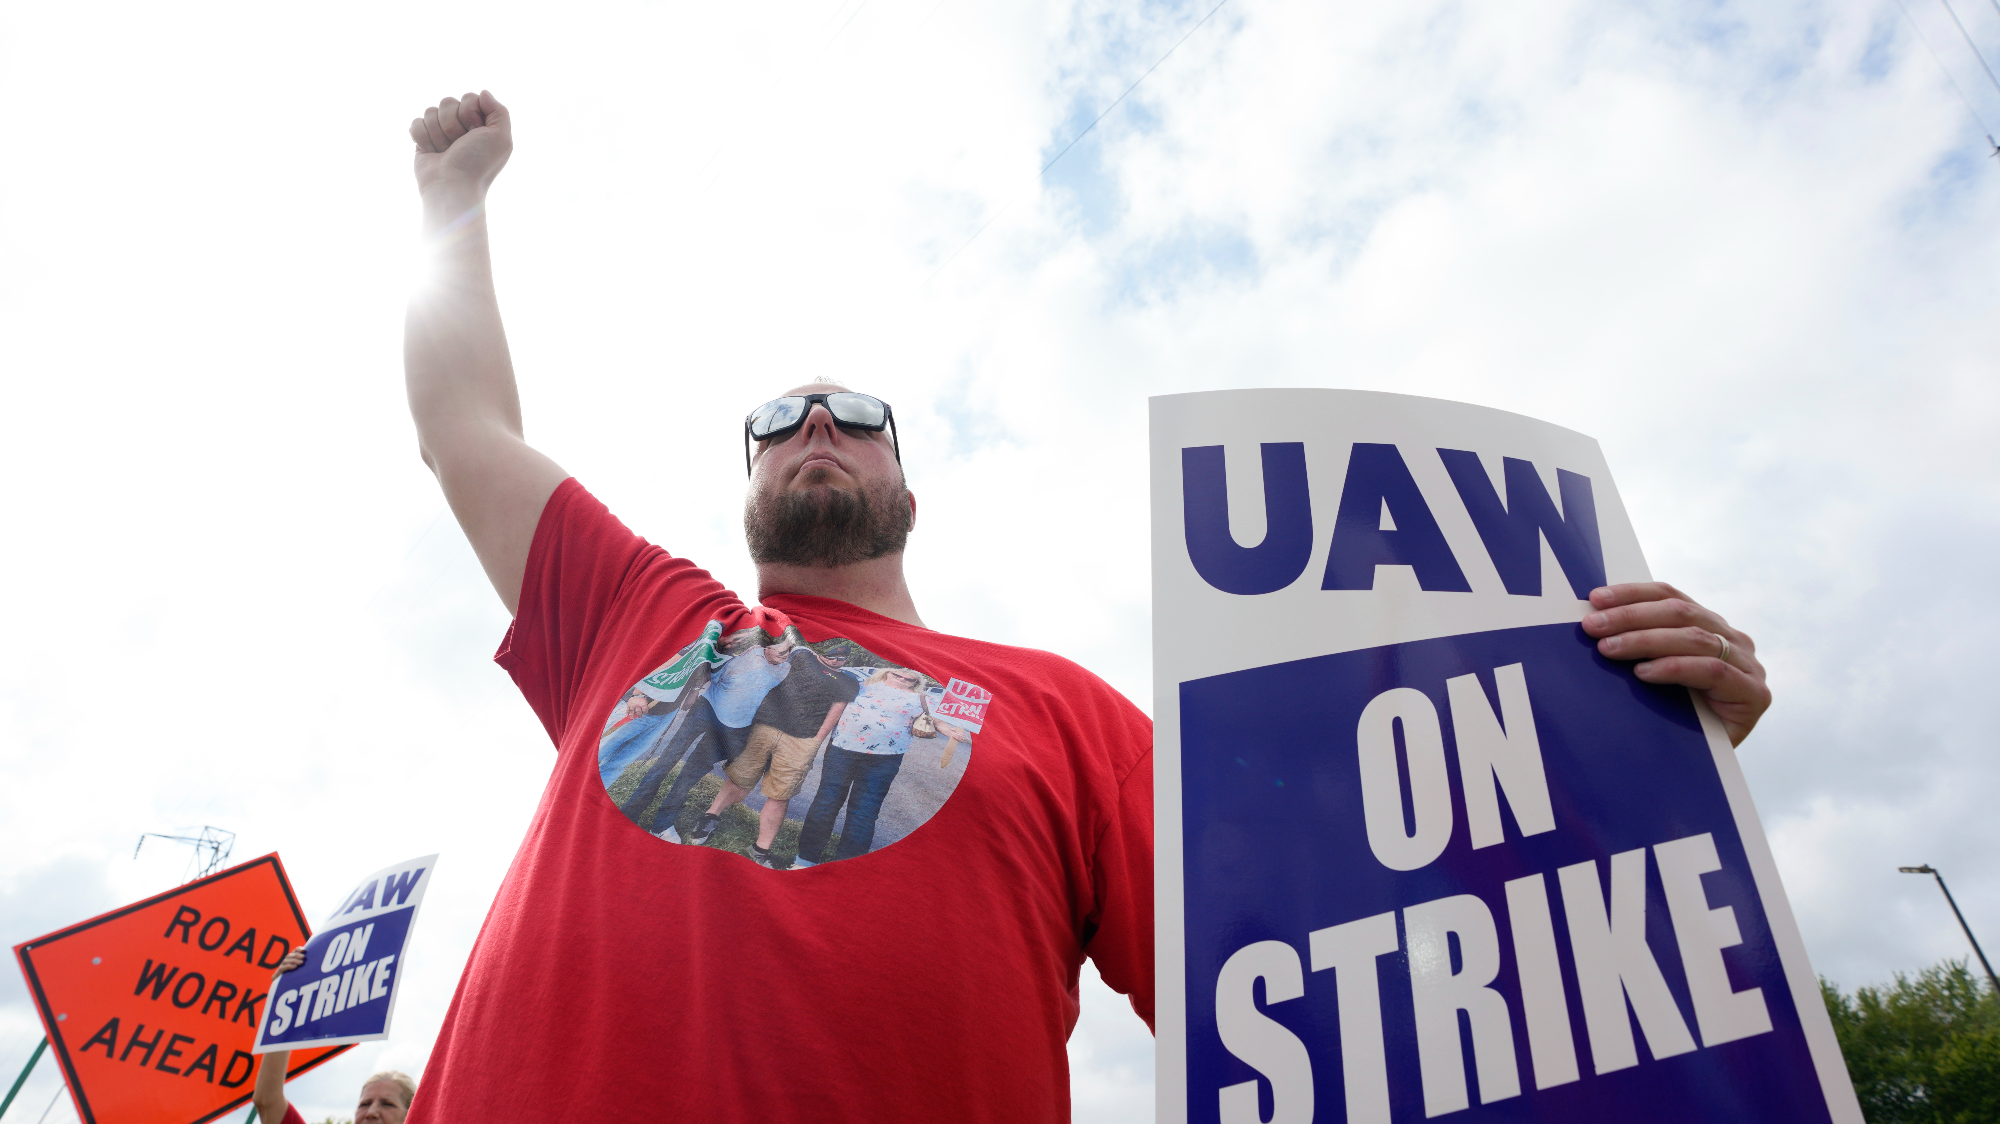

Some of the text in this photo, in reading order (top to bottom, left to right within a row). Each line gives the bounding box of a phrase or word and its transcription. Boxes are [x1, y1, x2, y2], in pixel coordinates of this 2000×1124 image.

[1181, 441, 1608, 601] UAW
[1357, 662, 1556, 872] ON
[163, 904, 290, 970] ROAD
[320, 922, 375, 973] ON
[133, 958, 269, 1029] WORK
[269, 954, 396, 1037] STRIKE
[1215, 832, 1774, 1124] STRIKE
[79, 1016, 255, 1089] AHEAD
